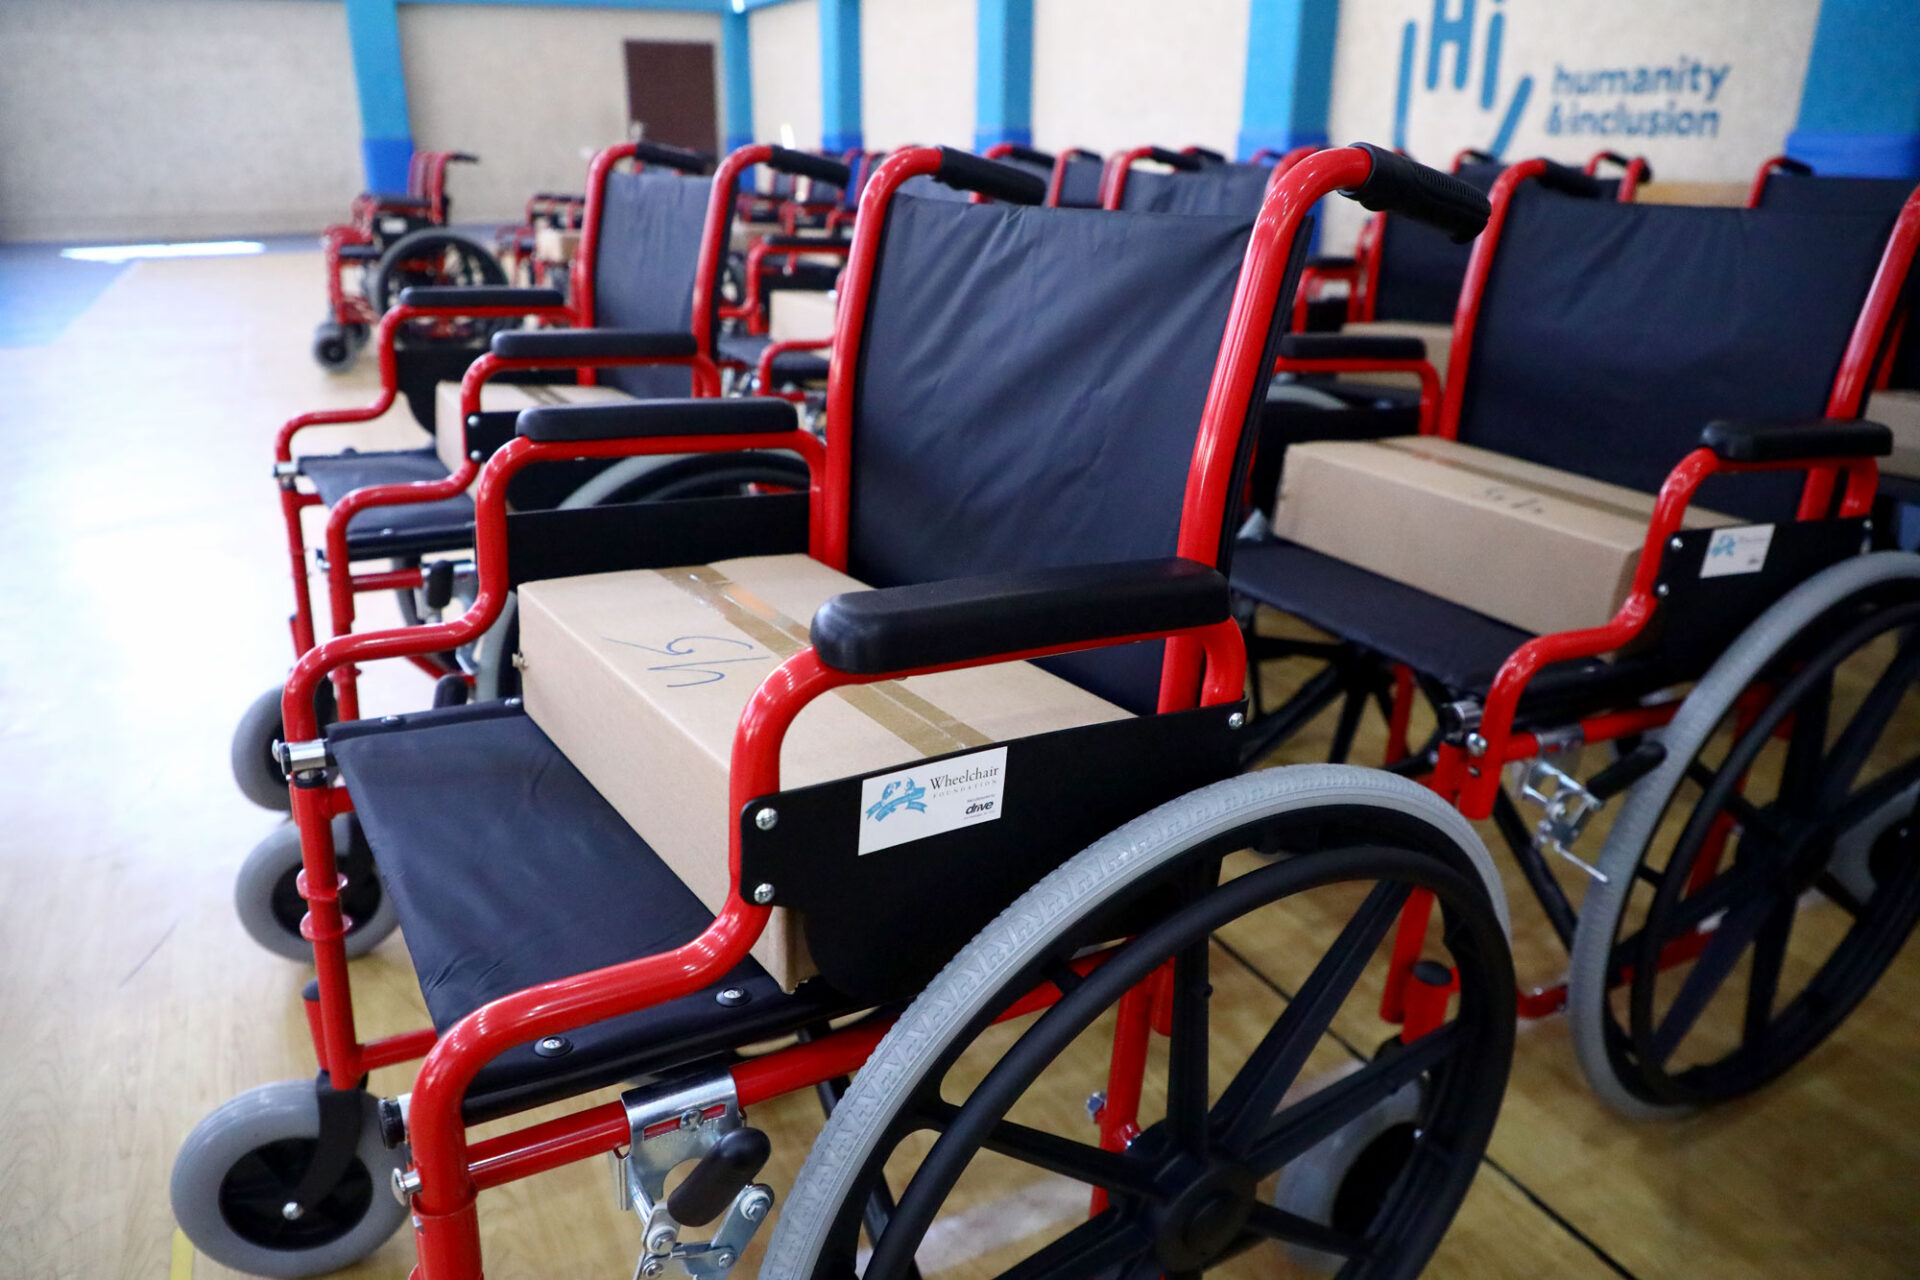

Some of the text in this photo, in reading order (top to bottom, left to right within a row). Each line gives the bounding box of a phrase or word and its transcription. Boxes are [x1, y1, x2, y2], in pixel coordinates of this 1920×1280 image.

[1553, 55, 1731, 101] humanity
[930, 767, 999, 790] Wheelchair
[965, 801, 994, 815] drive
